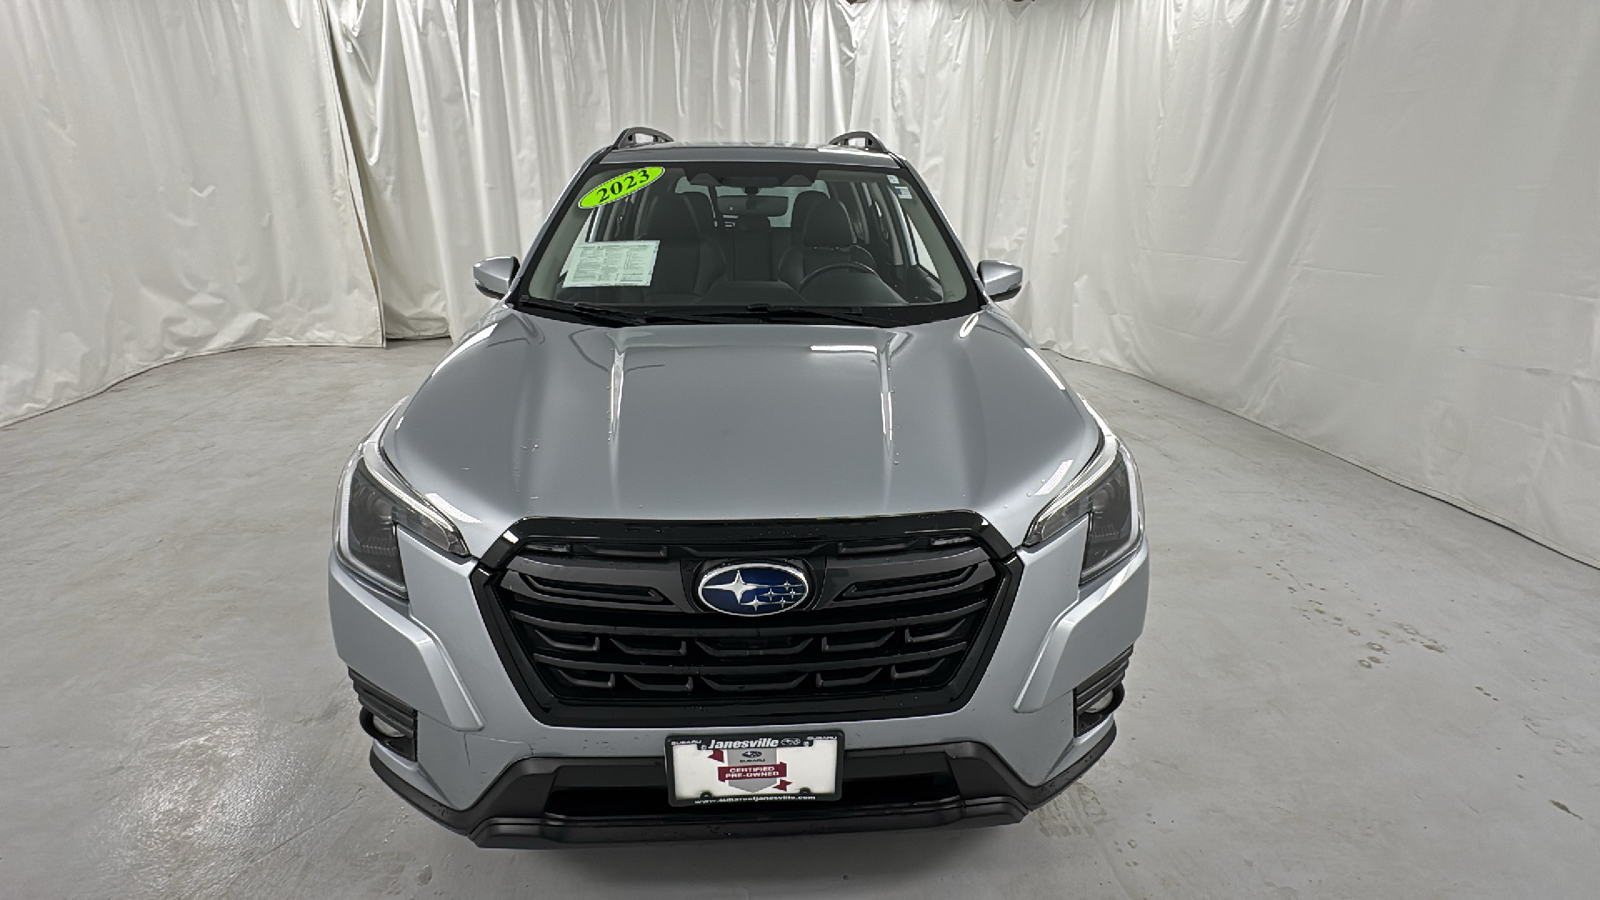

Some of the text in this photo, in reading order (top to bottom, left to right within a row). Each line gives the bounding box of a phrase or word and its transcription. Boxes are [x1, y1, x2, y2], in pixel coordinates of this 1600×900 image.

[597, 169, 650, 203] 2023
[708, 737, 779, 749] Janesville
[725, 771, 780, 779] PRE-OWNED
[729, 766, 775, 774] CERTIFIED
